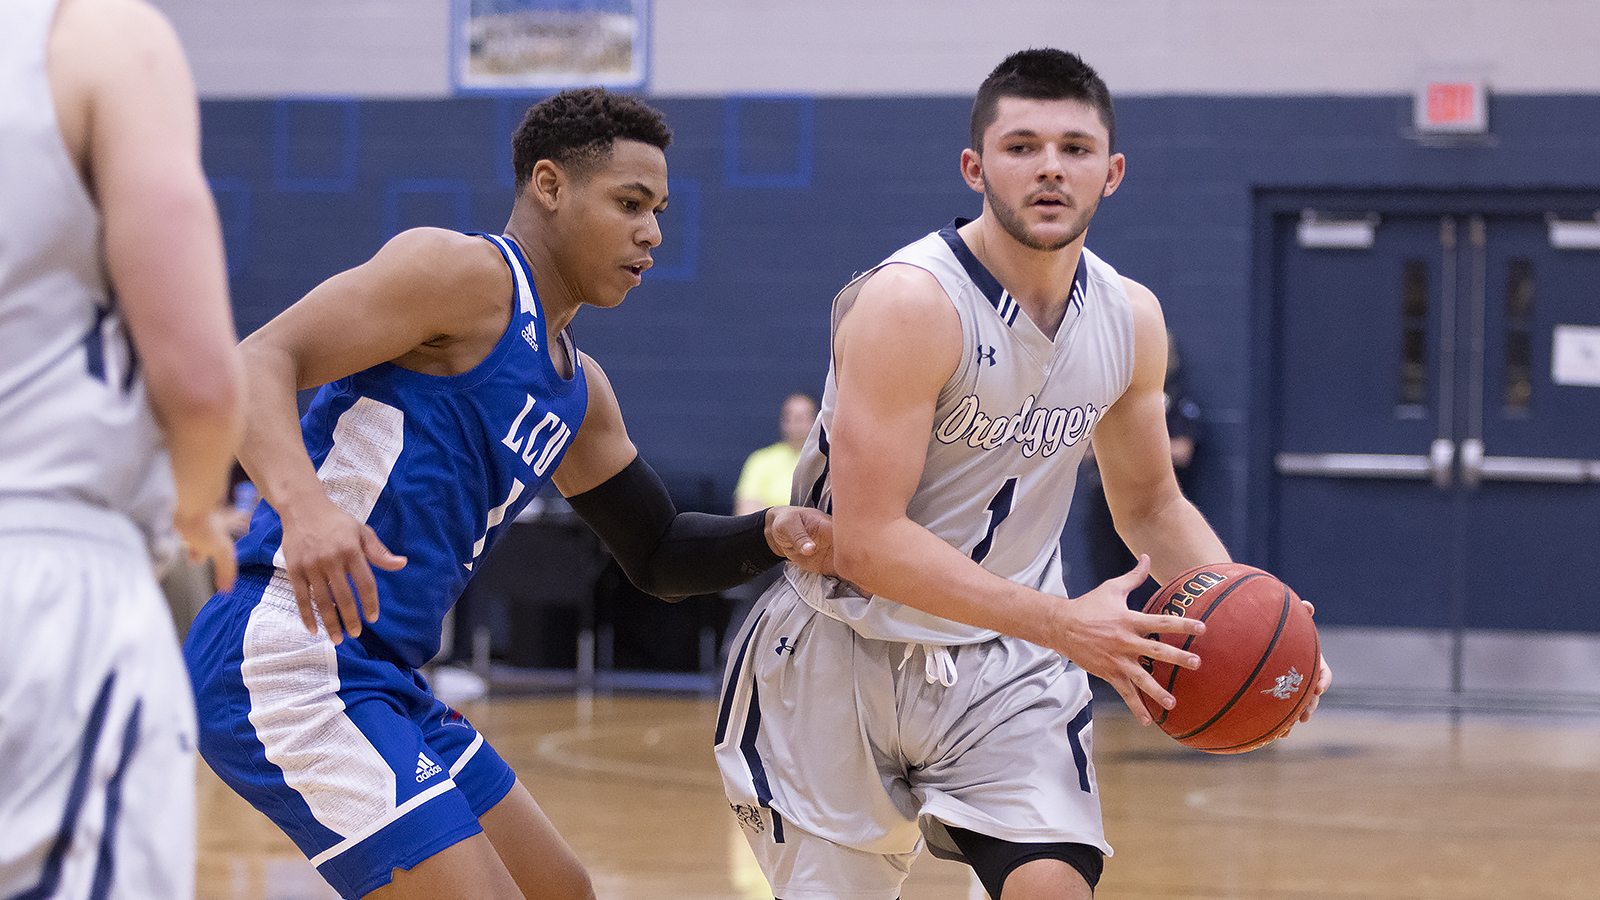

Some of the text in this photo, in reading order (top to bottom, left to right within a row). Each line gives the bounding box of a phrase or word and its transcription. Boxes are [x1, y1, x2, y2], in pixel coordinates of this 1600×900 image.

[501, 393, 571, 477] LCU
[935, 394, 1108, 458] Oredgger
[970, 474, 1021, 566] 1
[415, 764, 443, 783] adidas
